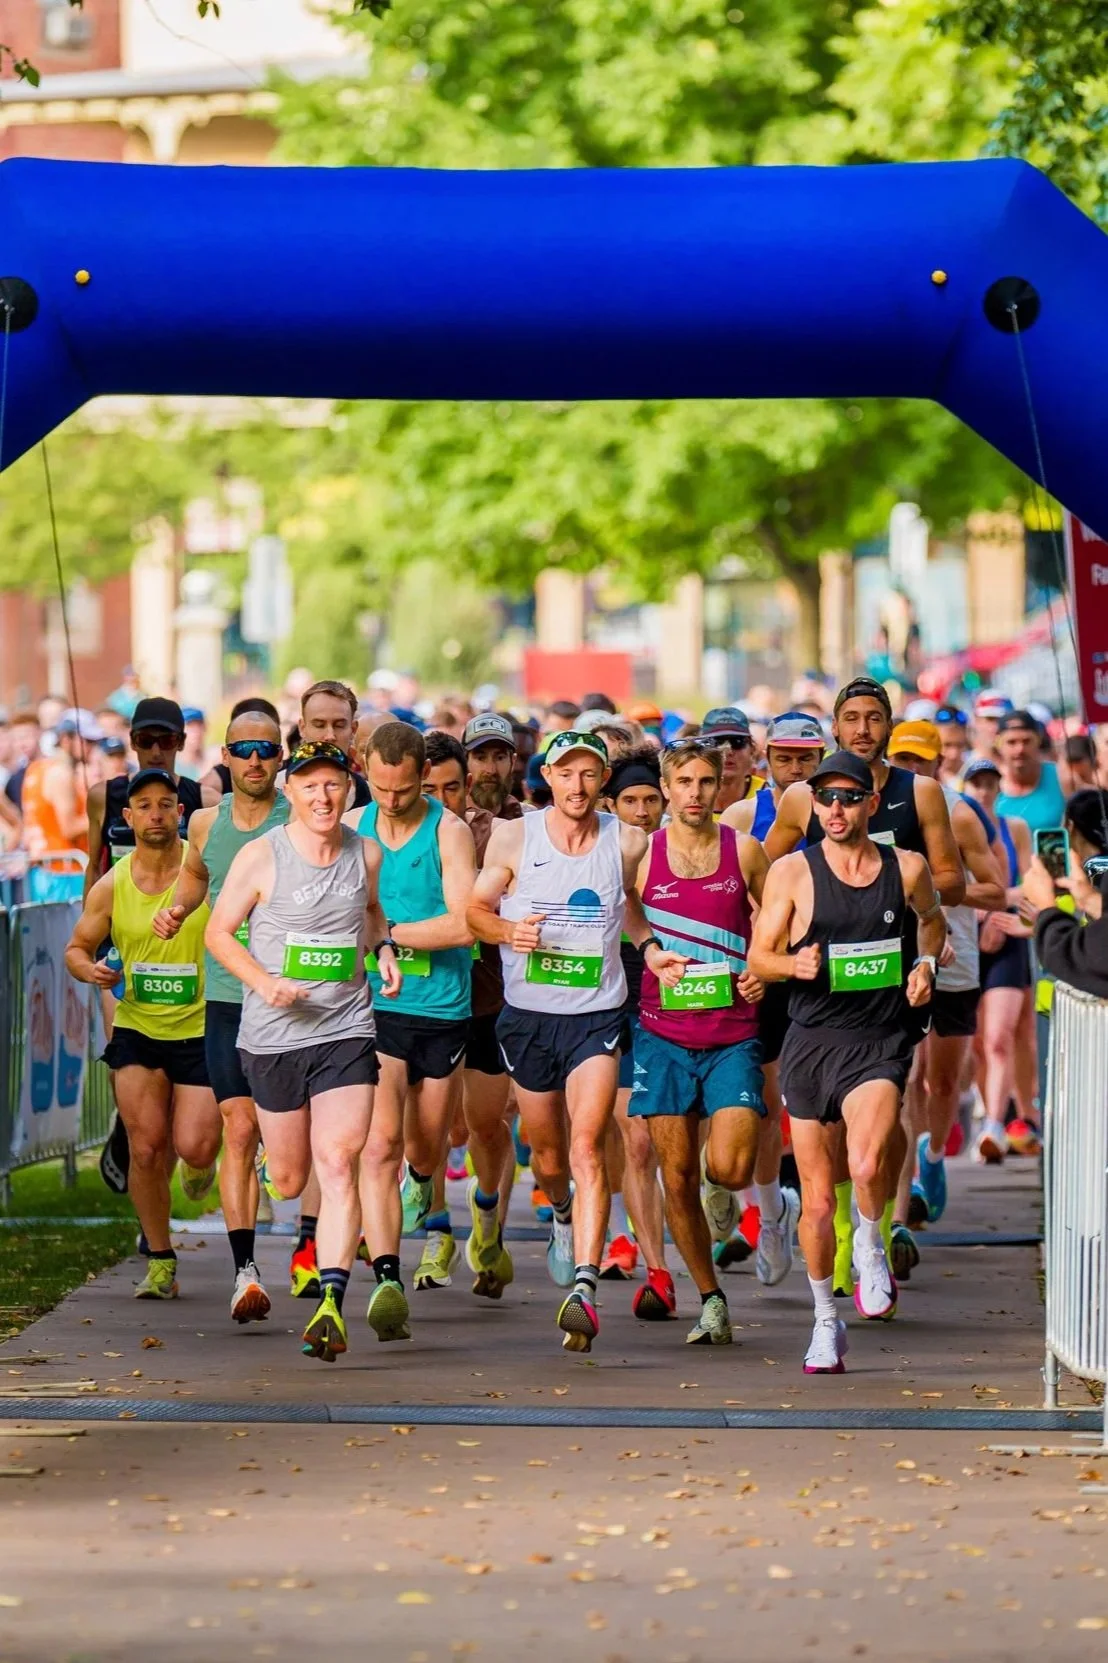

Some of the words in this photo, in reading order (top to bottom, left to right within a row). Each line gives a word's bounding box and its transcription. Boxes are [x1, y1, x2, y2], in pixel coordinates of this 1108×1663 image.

[298, 951, 342, 967] 8392
[541, 957, 586, 975] 8354
[844, 958, 888, 977] 8437
[143, 979, 184, 993] 8306
[673, 981, 717, 996] 8246
